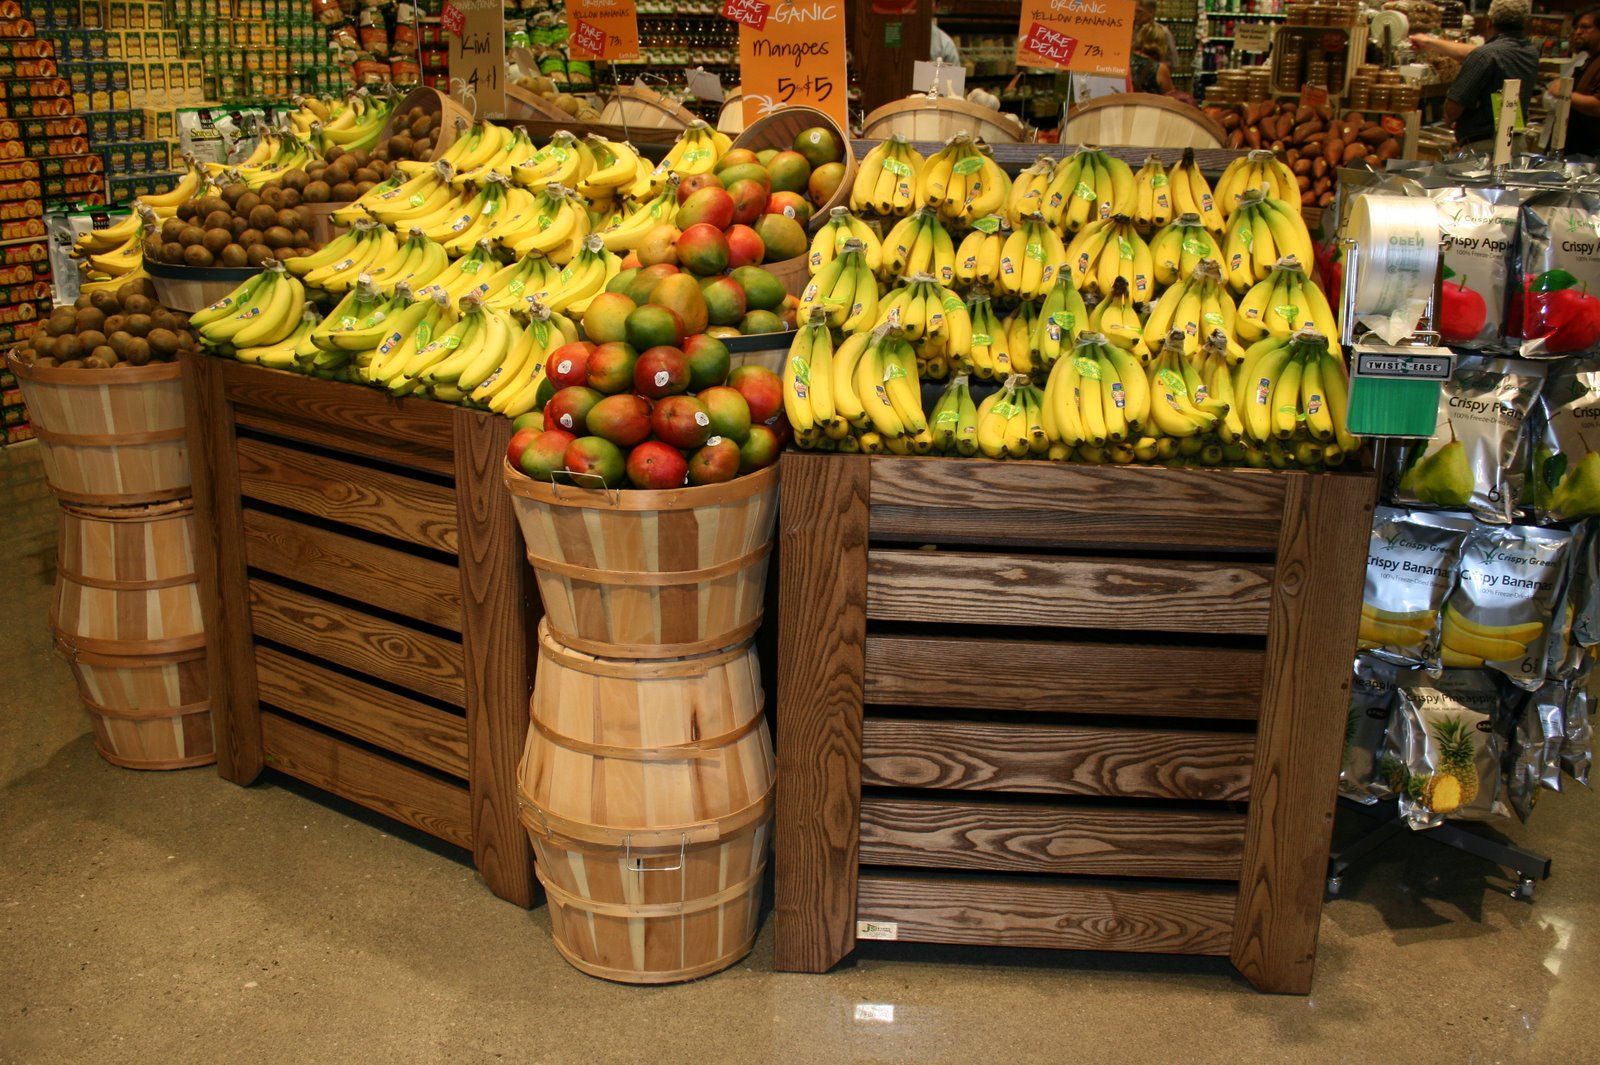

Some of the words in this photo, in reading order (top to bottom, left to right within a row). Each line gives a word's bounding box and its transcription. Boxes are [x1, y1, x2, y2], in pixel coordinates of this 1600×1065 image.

[727, 6, 763, 27] DEAL!
[767, 3, 837, 24] GANIC
[1031, 10, 1073, 23] YELLOW
[1074, 15, 1123, 28] BANANAS
[580, 23, 603, 40] FARE
[1035, 26, 1073, 48] FARE
[460, 32, 490, 59] Kiwi
[577, 34, 603, 54] DEAL!
[753, 39, 830, 67] Mangoes
[1030, 39, 1069, 62] DEAL!
[468, 67, 479, 94] 4
[777, 77, 796, 103] 5
[1441, 233, 1480, 250] Crispy
[1481, 237, 1515, 253] Appl
[1561, 240, 1595, 256] Crispy
[1448, 396, 1490, 414] Crispy
[1572, 406, 1600, 420] Crisp
[1487, 484, 1501, 503] 6
[1399, 539, 1429, 552] Crispy
[1497, 552, 1528, 565] Crispy
[1528, 556, 1557, 568] Green
[1501, 574, 1553, 592] Bananas
[1421, 643, 1432, 661] 6
[1520, 657, 1534, 674] 6
